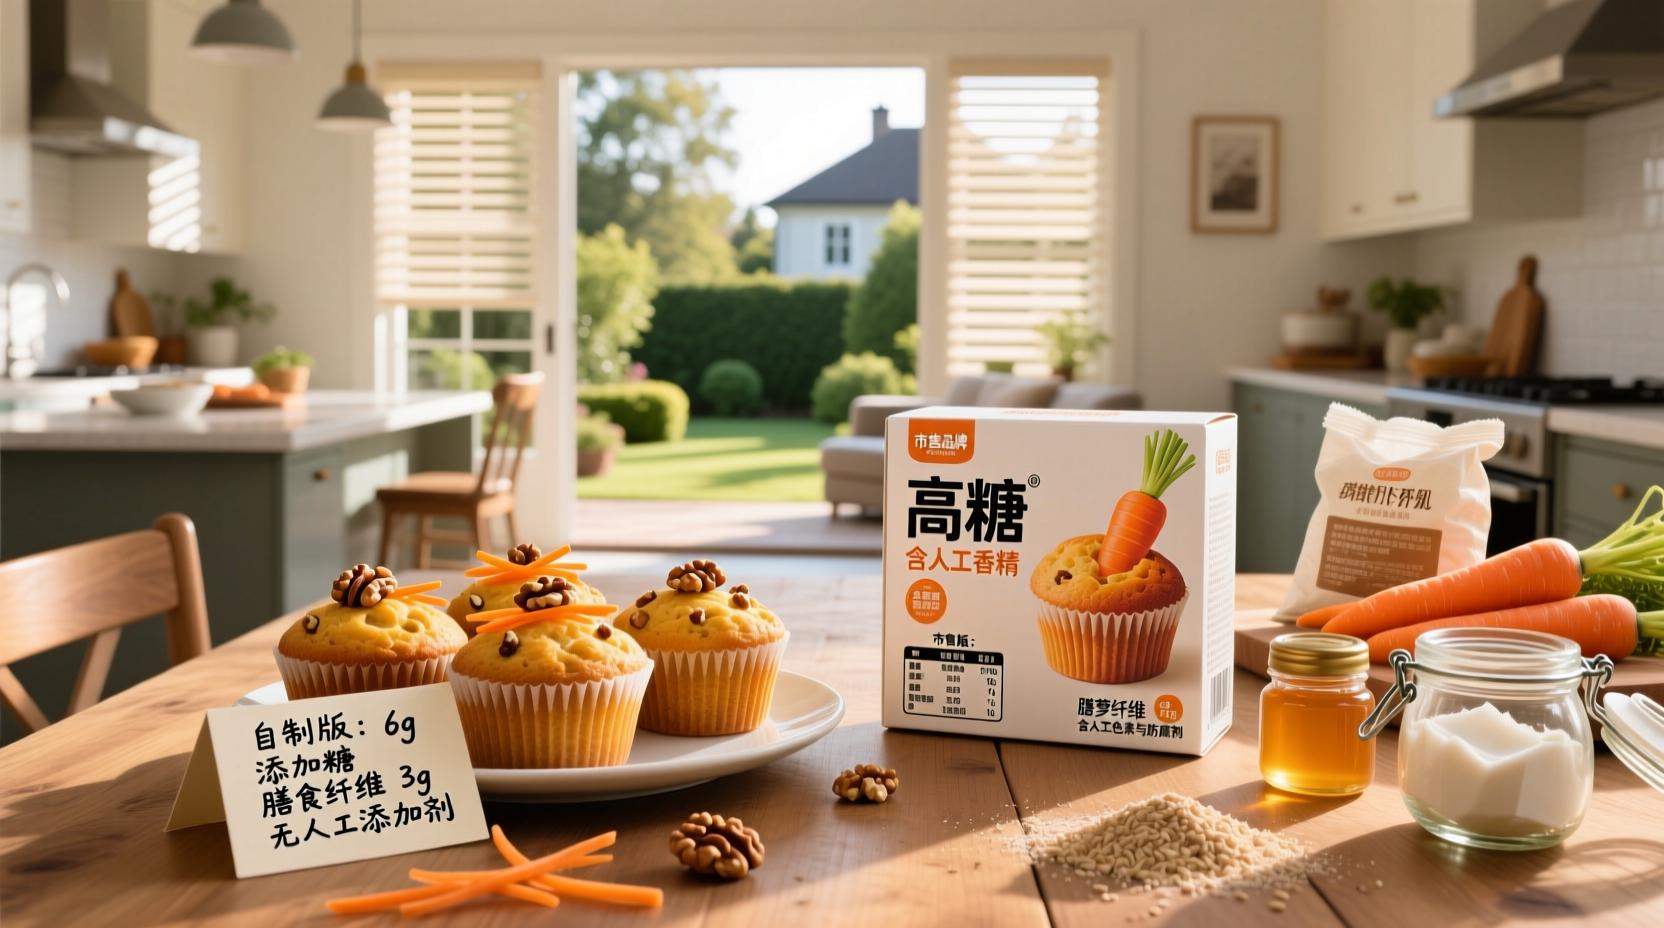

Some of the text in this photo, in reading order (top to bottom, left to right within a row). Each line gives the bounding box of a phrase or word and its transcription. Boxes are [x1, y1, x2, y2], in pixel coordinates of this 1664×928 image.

[908, 476, 1028, 543] 高糖
[905, 545, 1020, 577] 含人工香精
[255, 710, 416, 751] 自制版： 6g
[255, 745, 355, 785] 添加糖
[262, 765, 431, 818] 膳食纤维 3g
[270, 792, 455, 849] 无人工添加剂
